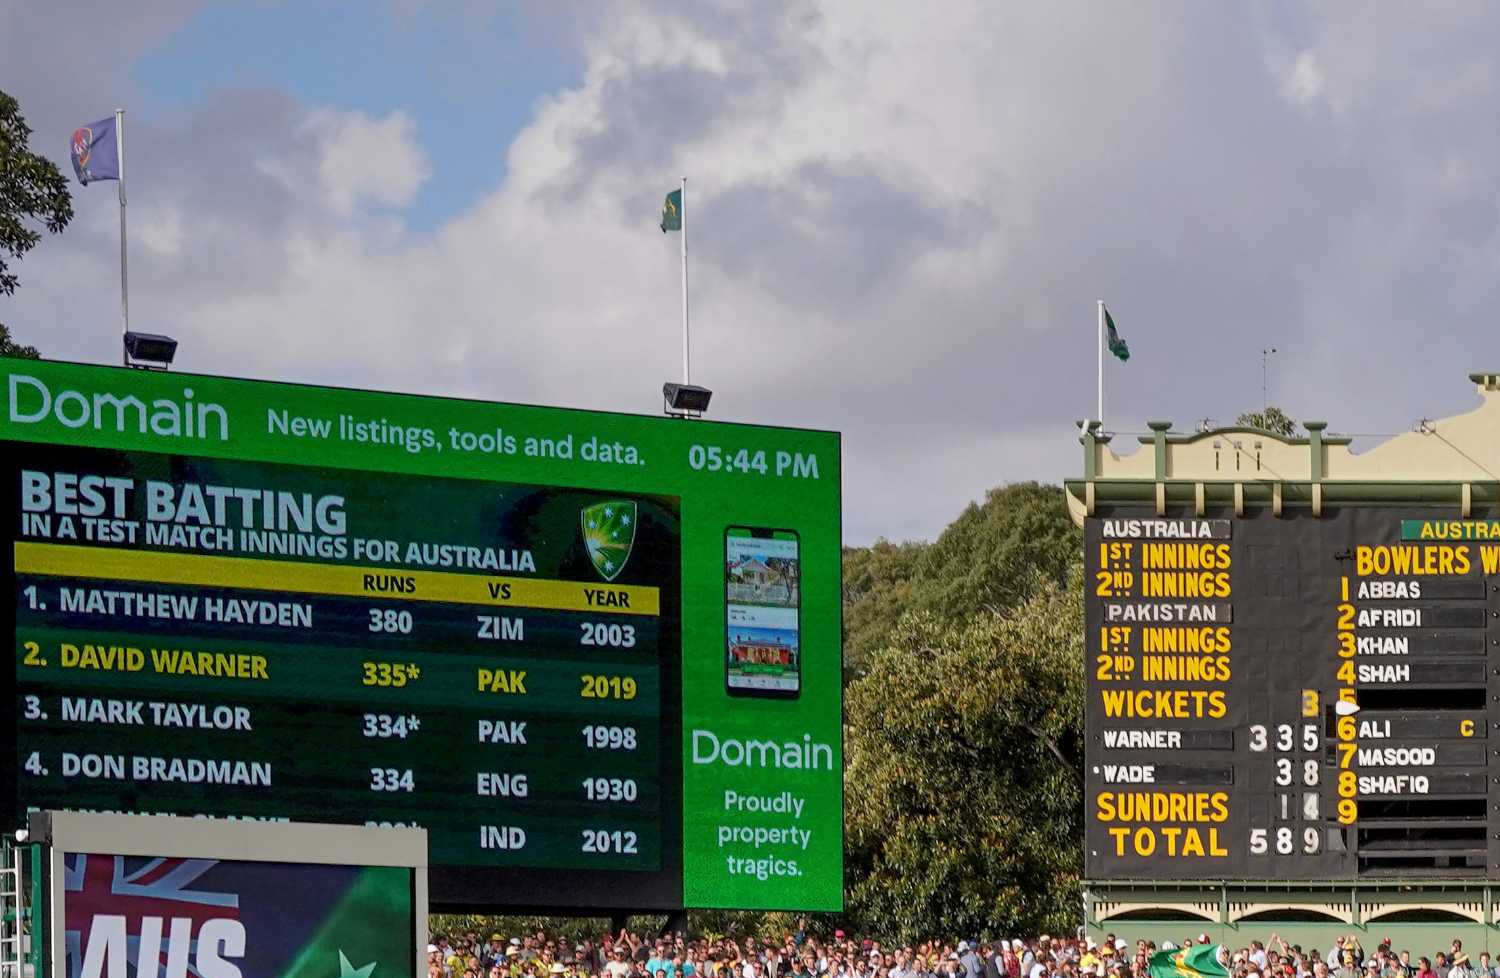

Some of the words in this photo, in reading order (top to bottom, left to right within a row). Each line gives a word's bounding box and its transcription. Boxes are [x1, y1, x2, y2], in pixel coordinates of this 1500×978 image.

[9, 374, 228, 440] Domain
[267, 409, 332, 439] New
[340, 413, 442, 453] listings,
[448, 428, 516, 455] tools
[524, 434, 573, 459] and
[581, 436, 645, 466] data.
[689, 445, 767, 474] 05:44
[776, 451, 820, 479] PM
[21, 470, 134, 518] BEST
[147, 484, 346, 535] BATTING
[22, 513, 51, 538] IN
[57, 516, 76, 540] A
[82, 518, 139, 544] TEST
[146, 521, 233, 551] MATCH
[240, 530, 347, 559] INNINGS
[354, 539, 400, 562] FOR
[405, 541, 536, 573] AUSTRALIA
[1102, 520, 1212, 538] AUSTRALIA
[1100, 543, 1132, 569] 1ST
[1142, 543, 1231, 569] INNINGS
[1357, 545, 1471, 576] BOWLERS
[363, 574, 416, 594] RUNS
[488, 582, 511, 600] VS
[584, 589, 630, 609] YEAR
[1096, 571, 1134, 597] 2ND
[1142, 571, 1231, 597] INNINGS
[1358, 581, 1421, 599] ABBAS
[23, 586, 46, 609] 1.
[60, 588, 200, 620] MATTHEW
[205, 599, 312, 628] HAYDEN
[368, 609, 413, 634] 380
[477, 615, 524, 641] ZIM
[581, 622, 636, 648] 2003
[1108, 604, 1216, 622] PAKISTAN
[1337, 604, 1355, 630] 2
[1357, 608, 1421, 627] AFRIDI
[1101, 627, 1132, 652] 1ST
[1142, 626, 1231, 653] INNINGS
[1337, 632, 1356, 657] 3
[1357, 637, 1409, 654] KHAN
[23, 642, 47, 666] 2.
[60, 643, 145, 672] DAVID
[152, 650, 268, 680] WARNER
[478, 670, 526, 695] PAK
[580, 675, 637, 700] 2019
[1096, 655, 1135, 680] 2ND
[1142, 655, 1231, 681] INNINGS
[1336, 660, 1356, 685] 4
[1358, 664, 1410, 682] SHAH
[1102, 690, 1227, 718] WICKETS
[1302, 690, 1319, 717] 3
[24, 695, 47, 720] 3.
[61, 697, 144, 725] MARK
[150, 703, 252, 731] TAYLOR
[478, 720, 527, 745] PAK
[582, 725, 637, 750] 1998
[1337, 716, 1356, 741] 6
[1359, 720, 1391, 738] ALI
[1460, 720, 1474, 737] C
[692, 729, 833, 770] Domain
[1103, 730, 1182, 749] WARNER
[1337, 743, 1357, 769] 7
[1358, 748, 1435, 766] MASOOD
[25, 752, 48, 776] 4.
[62, 753, 125, 780] DON
[133, 757, 272, 787] BRADMAN
[370, 767, 415, 792] 334
[477, 773, 528, 798] ENG
[582, 778, 637, 802] 1930
[1103, 765, 1155, 783] WADE
[1337, 771, 1357, 798] 8
[1358, 776, 1429, 794] SHAFIQ
[724, 790, 804, 819] Proudly
[1097, 792, 1229, 822] SUNDRIES
[1337, 799, 1358, 824] 9
[480, 825, 526, 850] IND
[581, 829, 638, 853] 2012
[718, 823, 811, 852] property
[1108, 827, 1228, 856] TOTAL
[726, 855, 802, 881] tragics.
